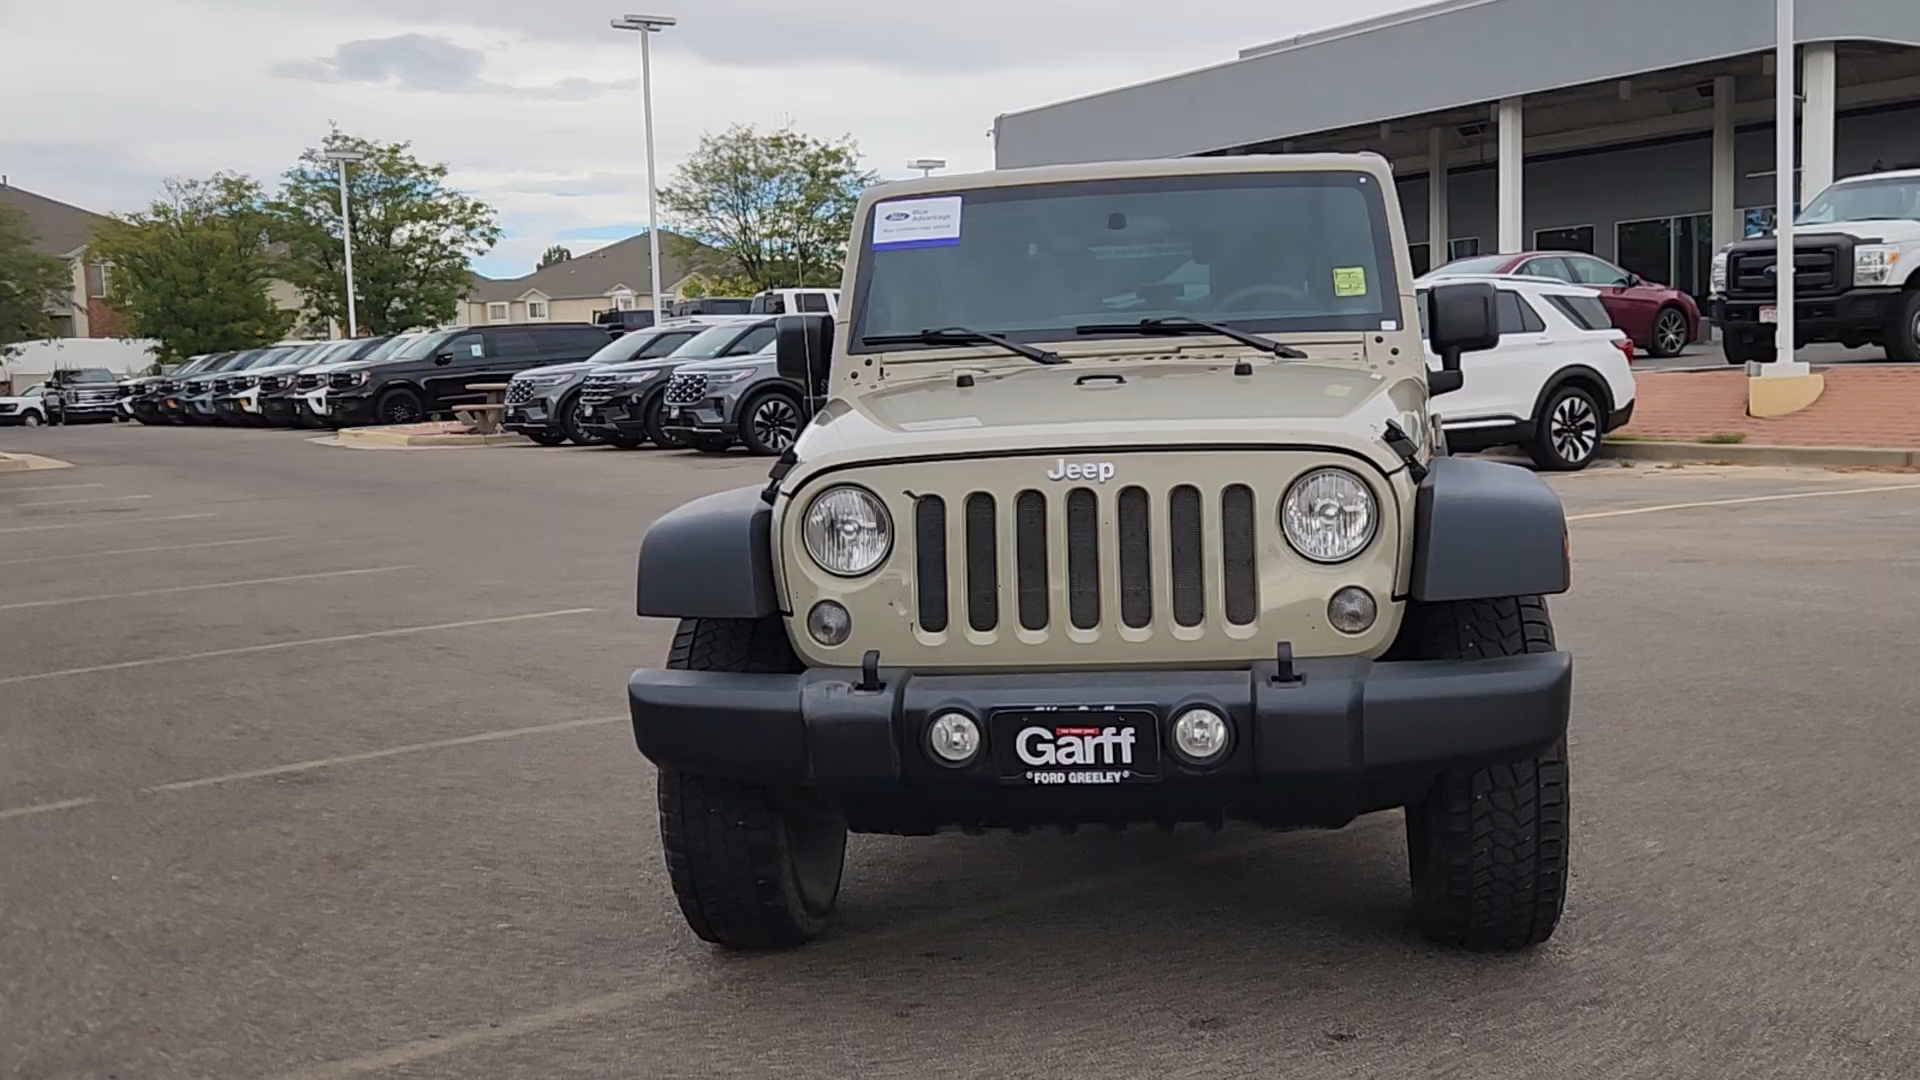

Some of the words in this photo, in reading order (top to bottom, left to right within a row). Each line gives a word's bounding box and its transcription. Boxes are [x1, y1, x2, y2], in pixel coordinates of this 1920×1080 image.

[912, 214, 951, 222] Advantage
[1047, 458, 1115, 483] Jeep
[1015, 726, 1136, 766] Garff
[1034, 771, 1066, 784] FORD
[1068, 771, 1122, 784] GREELEY
